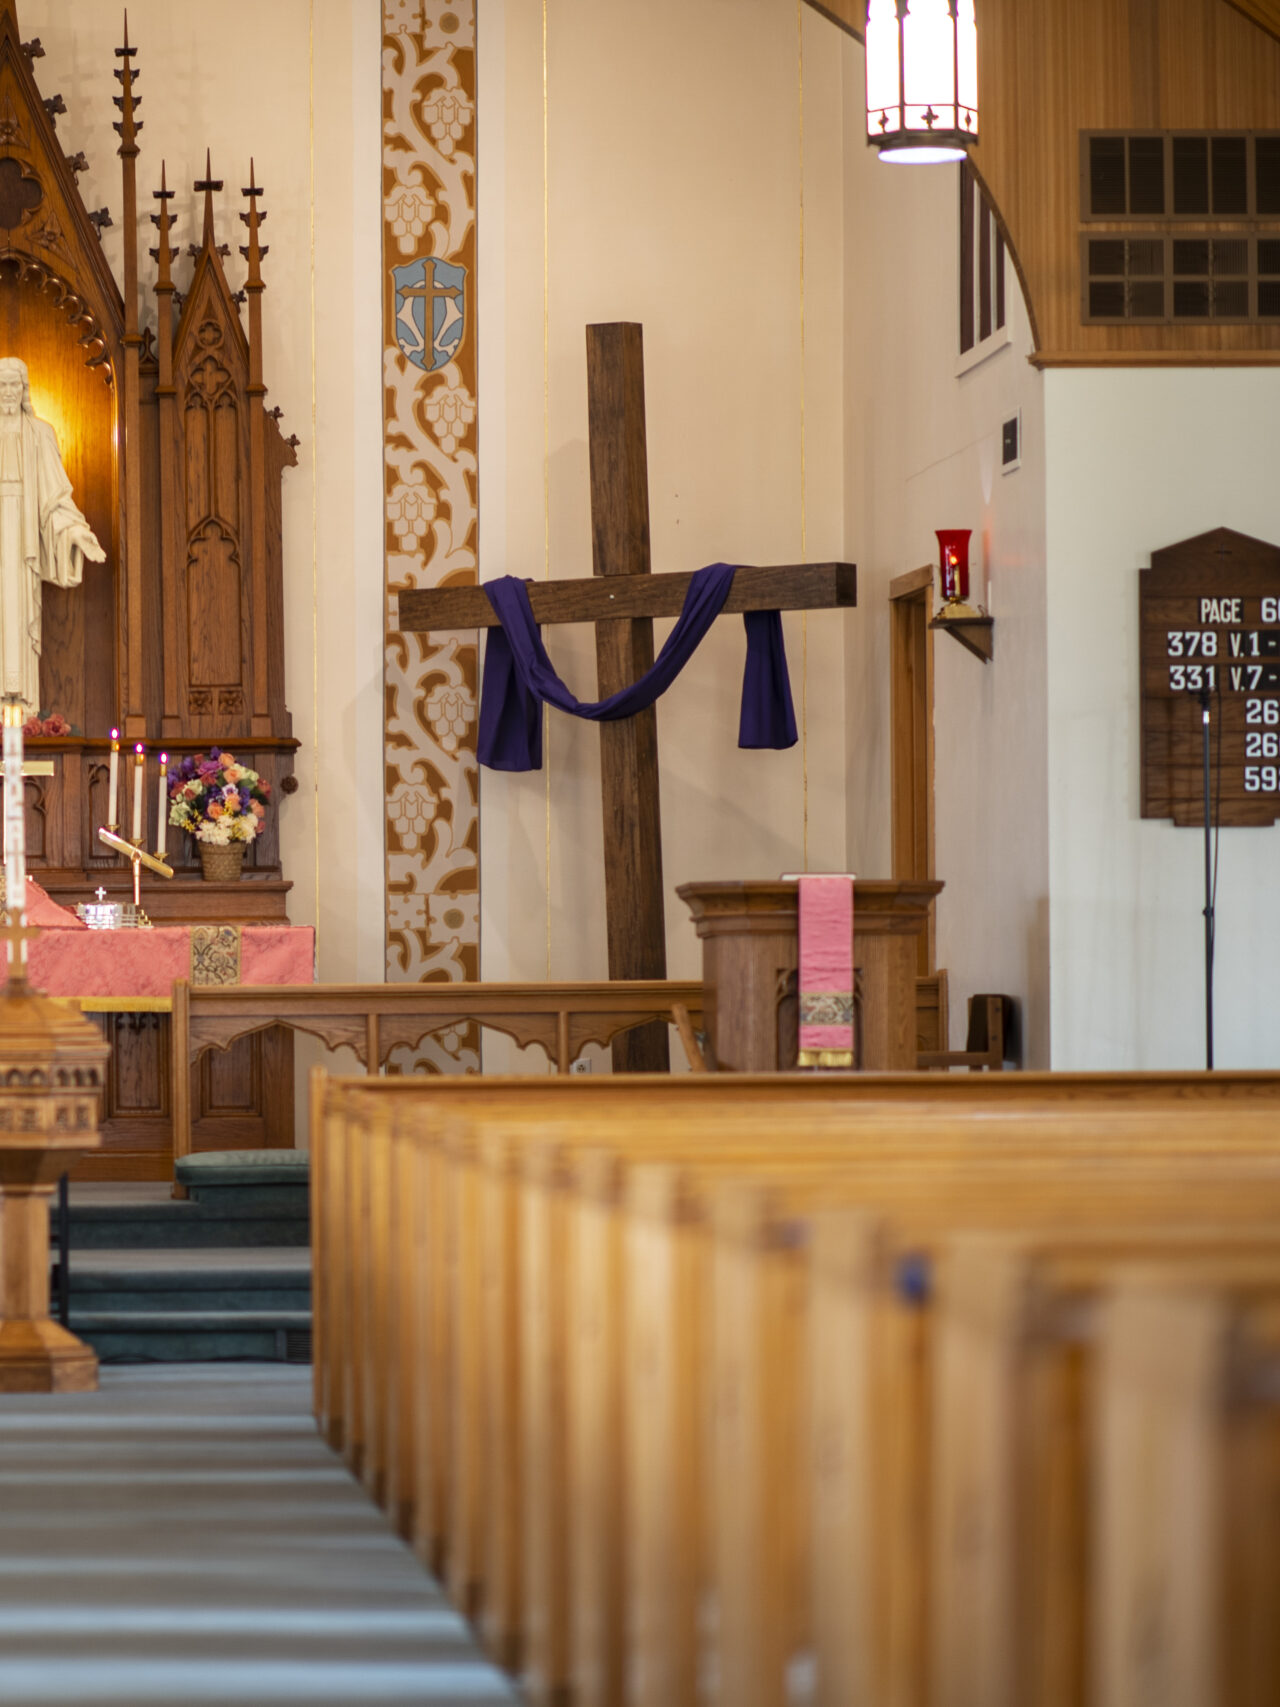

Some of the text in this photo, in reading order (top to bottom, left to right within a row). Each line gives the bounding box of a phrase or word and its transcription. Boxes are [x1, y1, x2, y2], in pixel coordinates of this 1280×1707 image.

[1201, 597, 1280, 623] PAGE 6
[1167, 631, 1218, 657] 378
[1169, 665, 1216, 691] 331
[1246, 698, 1280, 725] 26
[1246, 732, 1280, 758] 26
[1244, 766, 1280, 792] 59
